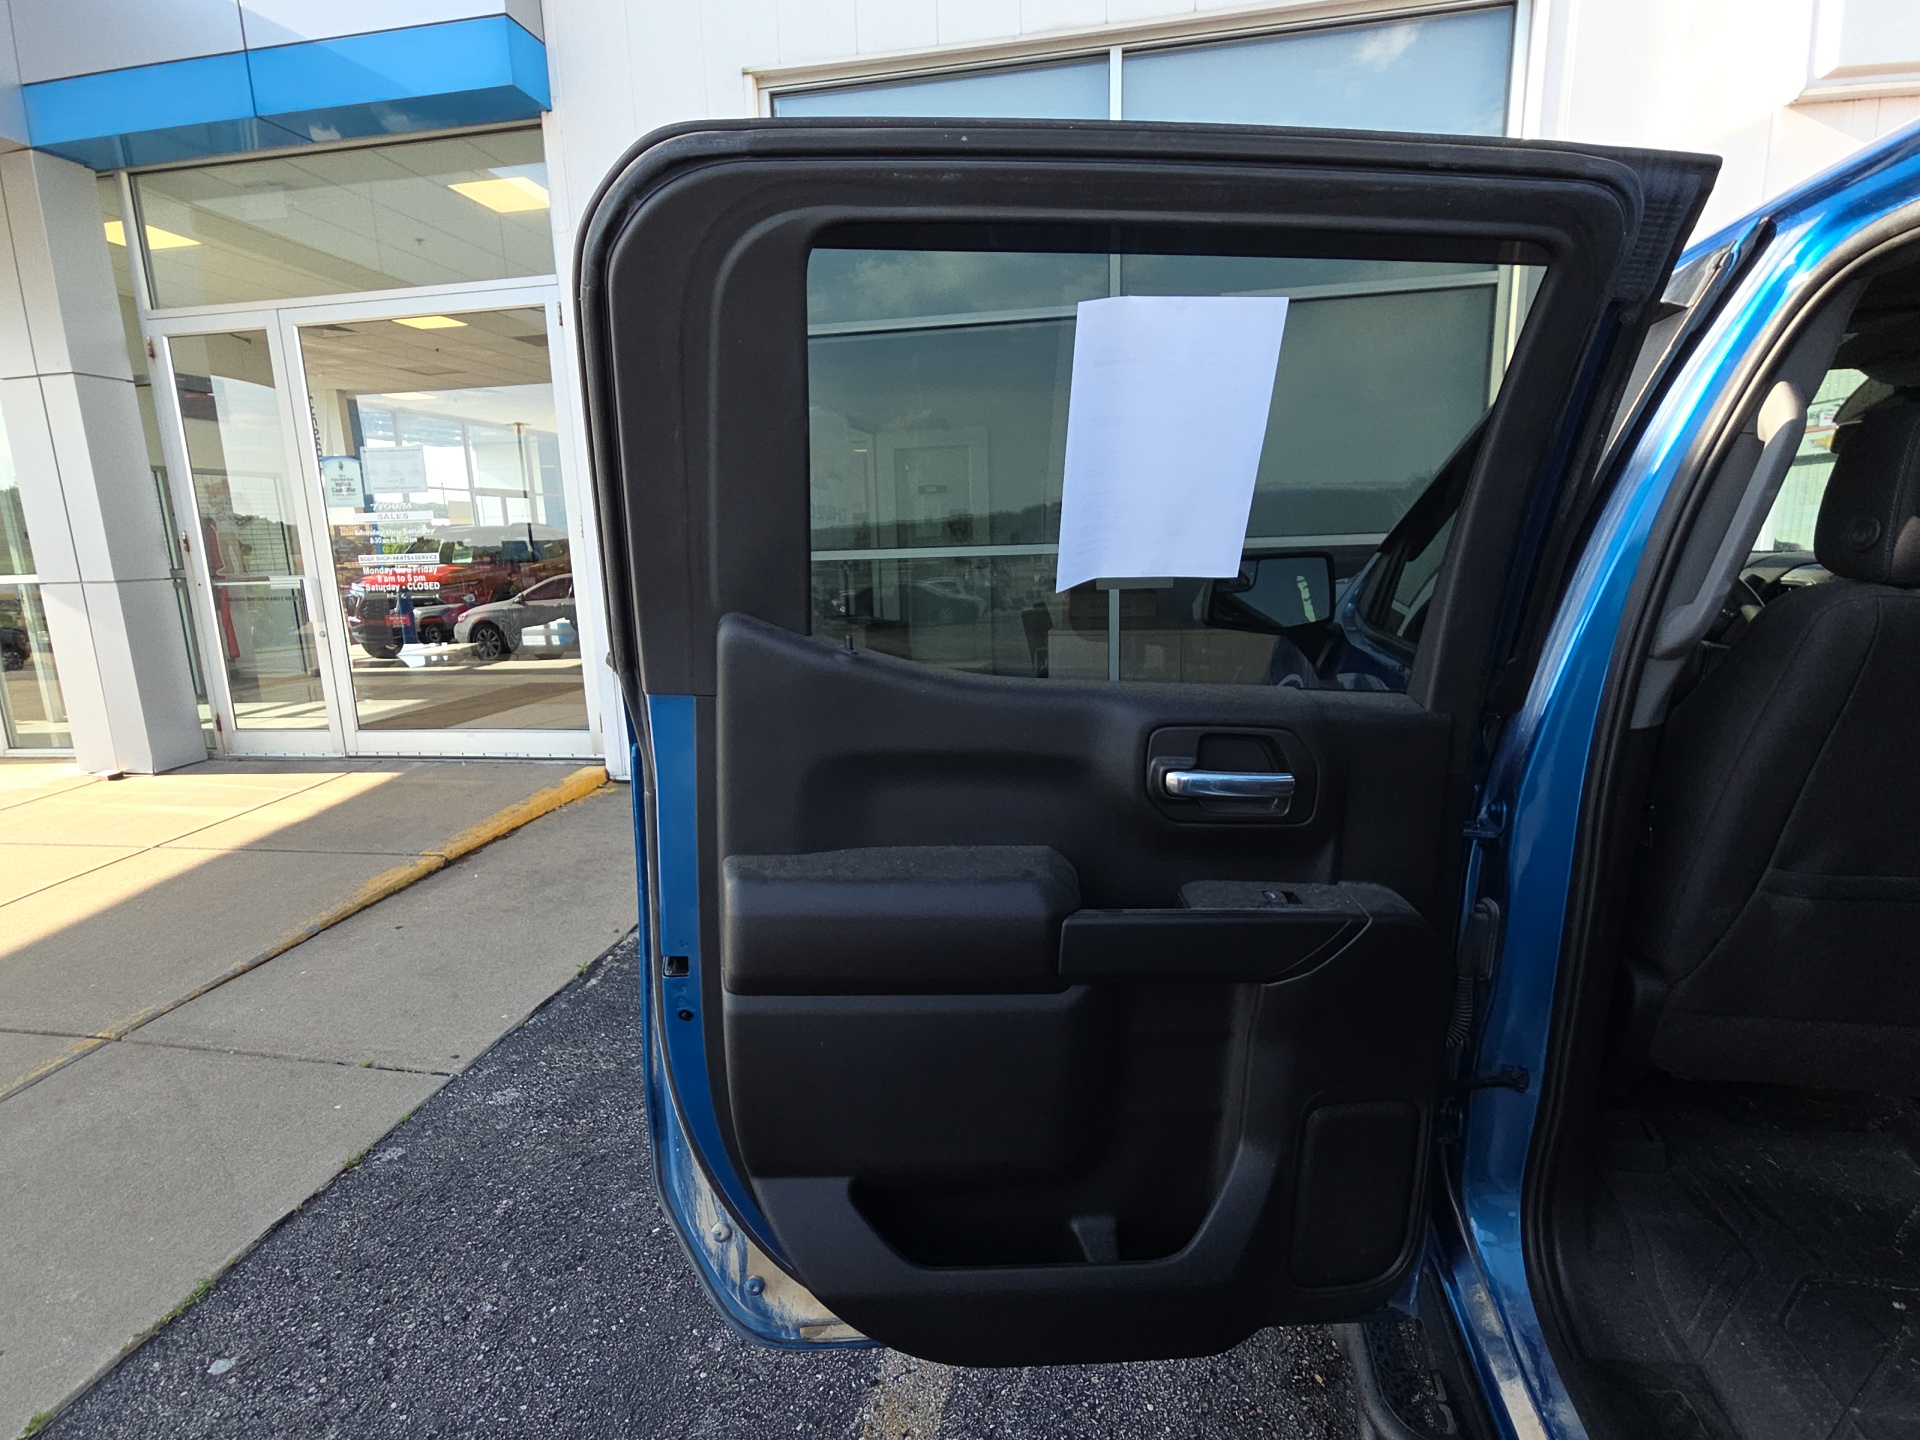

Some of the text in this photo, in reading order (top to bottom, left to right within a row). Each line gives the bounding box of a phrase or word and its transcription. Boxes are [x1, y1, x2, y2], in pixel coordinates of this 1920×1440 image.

[370, 501, 412, 511] Hours
[362, 566, 393, 575] Monday
[413, 566, 438, 575] Friday
[413, 575, 426, 583] pm
[365, 583, 400, 592] Saturday
[407, 581, 440, 590] CLOSED
